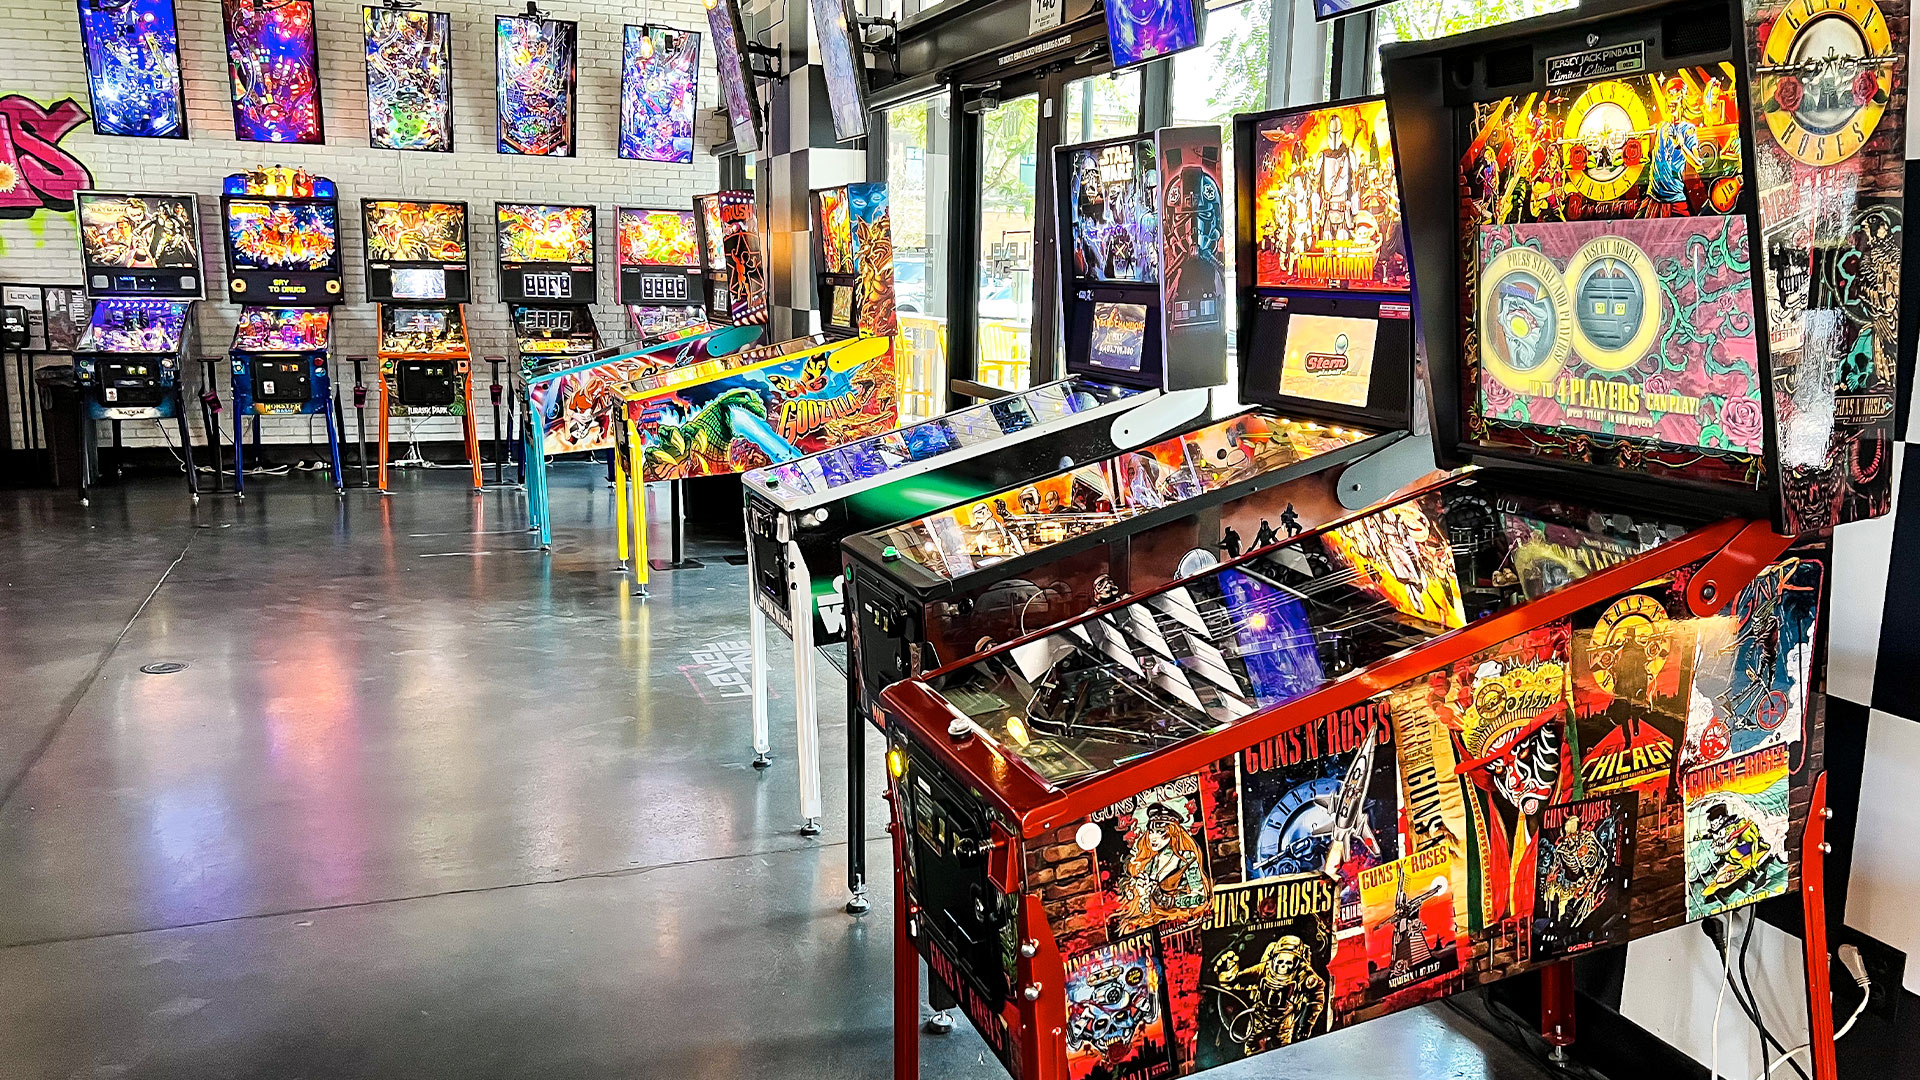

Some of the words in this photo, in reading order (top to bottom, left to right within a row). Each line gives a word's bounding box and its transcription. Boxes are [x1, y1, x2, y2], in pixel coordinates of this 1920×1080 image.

[1550, 67, 1582, 82] Limited
[1584, 63, 1615, 77] Edition
[1551, 56, 1579, 70] JERSEY
[1579, 53, 1602, 66] JACK
[1602, 46, 1640, 61] PINBALL
[1100, 145, 1134, 165] STAR
[1780, 121, 1865, 161] ROSES
[1100, 163, 1134, 182] WARS
[723, 204, 753, 223] RUSH
[1297, 256, 1374, 280] MANDALORIAN
[1582, 241, 1611, 263] INSERT
[1612, 241, 1642, 265] MONEY
[1309, 356, 1345, 369] Stern
[432, 406, 449, 415] PARK
[1529, 380, 1541, 396] UP
[1541, 381, 1554, 398] TO
[1557, 378, 1568, 404] 4
[1570, 378, 1640, 414] PLAYERS
[1645, 392, 1667, 411] CAN
[1834, 398, 1855, 416] GUNS
[1863, 397, 1886, 415] ROSES
[777, 392, 862, 445] GODZILLA
[1245, 726, 1300, 775] GUNS
[1327, 701, 1391, 755] ROSES
[1688, 762, 1728, 800] GUNS
[1744, 744, 1787, 779] ROSES
[1091, 797, 1135, 823] GUNS
[1155, 775, 1198, 801] ROSES
[1266, 781, 1318, 831] GUNS
[1407, 765, 1443, 836] GUNS
[1543, 806, 1569, 830] GUNS
[1581, 799, 1611, 823] ROSES
[1362, 864, 1393, 890] GUNS
[1411, 845, 1447, 873] ROSES
[1277, 879, 1332, 919] ROSES
[1109, 932, 1153, 964] ROSES
